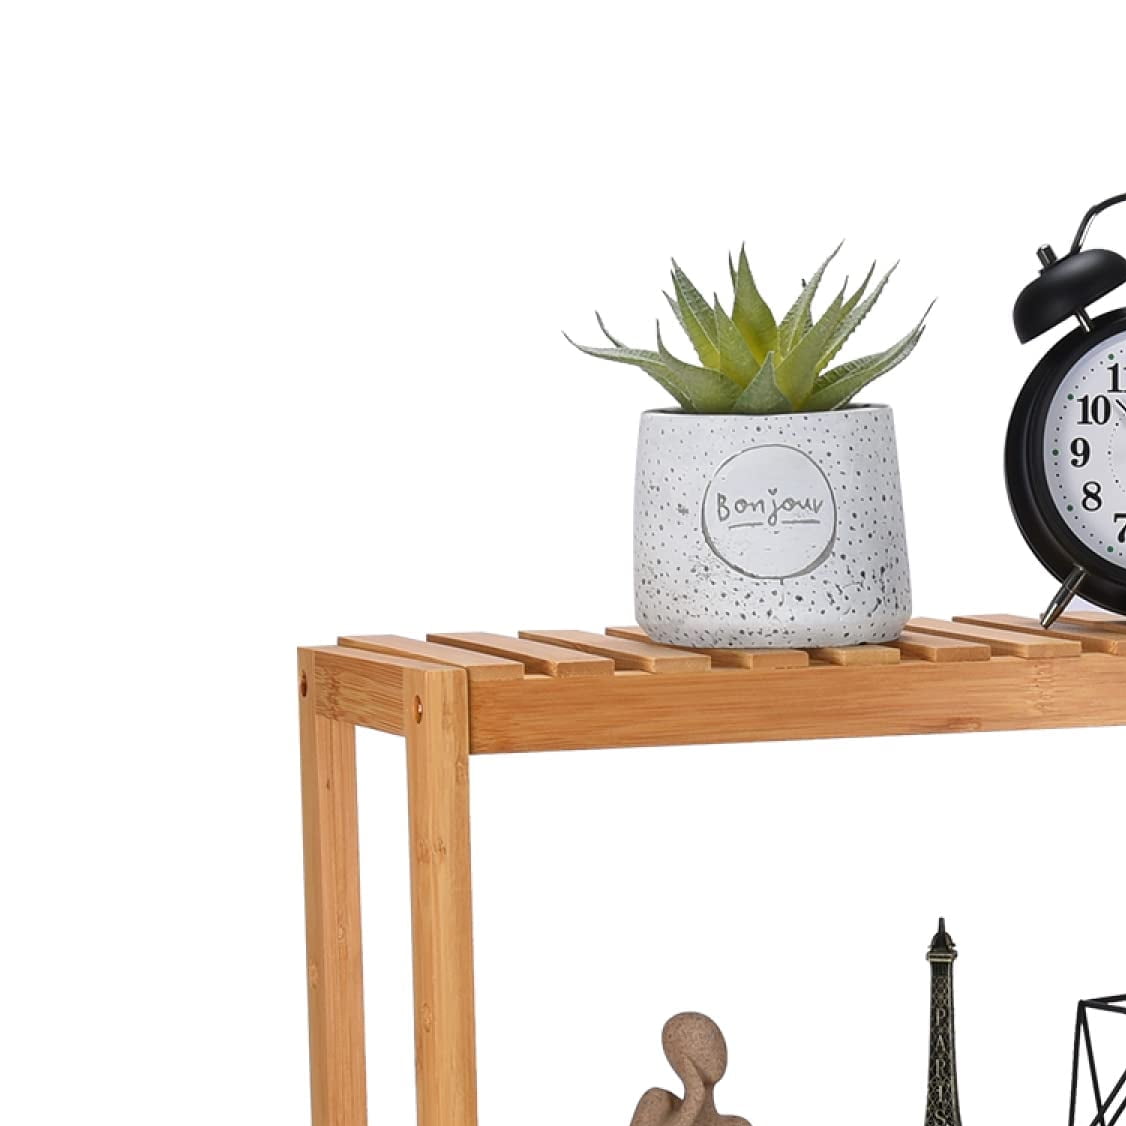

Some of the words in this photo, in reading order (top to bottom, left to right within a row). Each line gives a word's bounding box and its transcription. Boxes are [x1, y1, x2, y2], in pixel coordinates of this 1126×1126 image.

[1077, 395, 1111, 425] 10
[1070, 438, 1090, 468] 9
[717, 488, 823, 526] Bonjour
[1082, 481, 1102, 512] 8
[935, 1007, 946, 1126] PARIS
